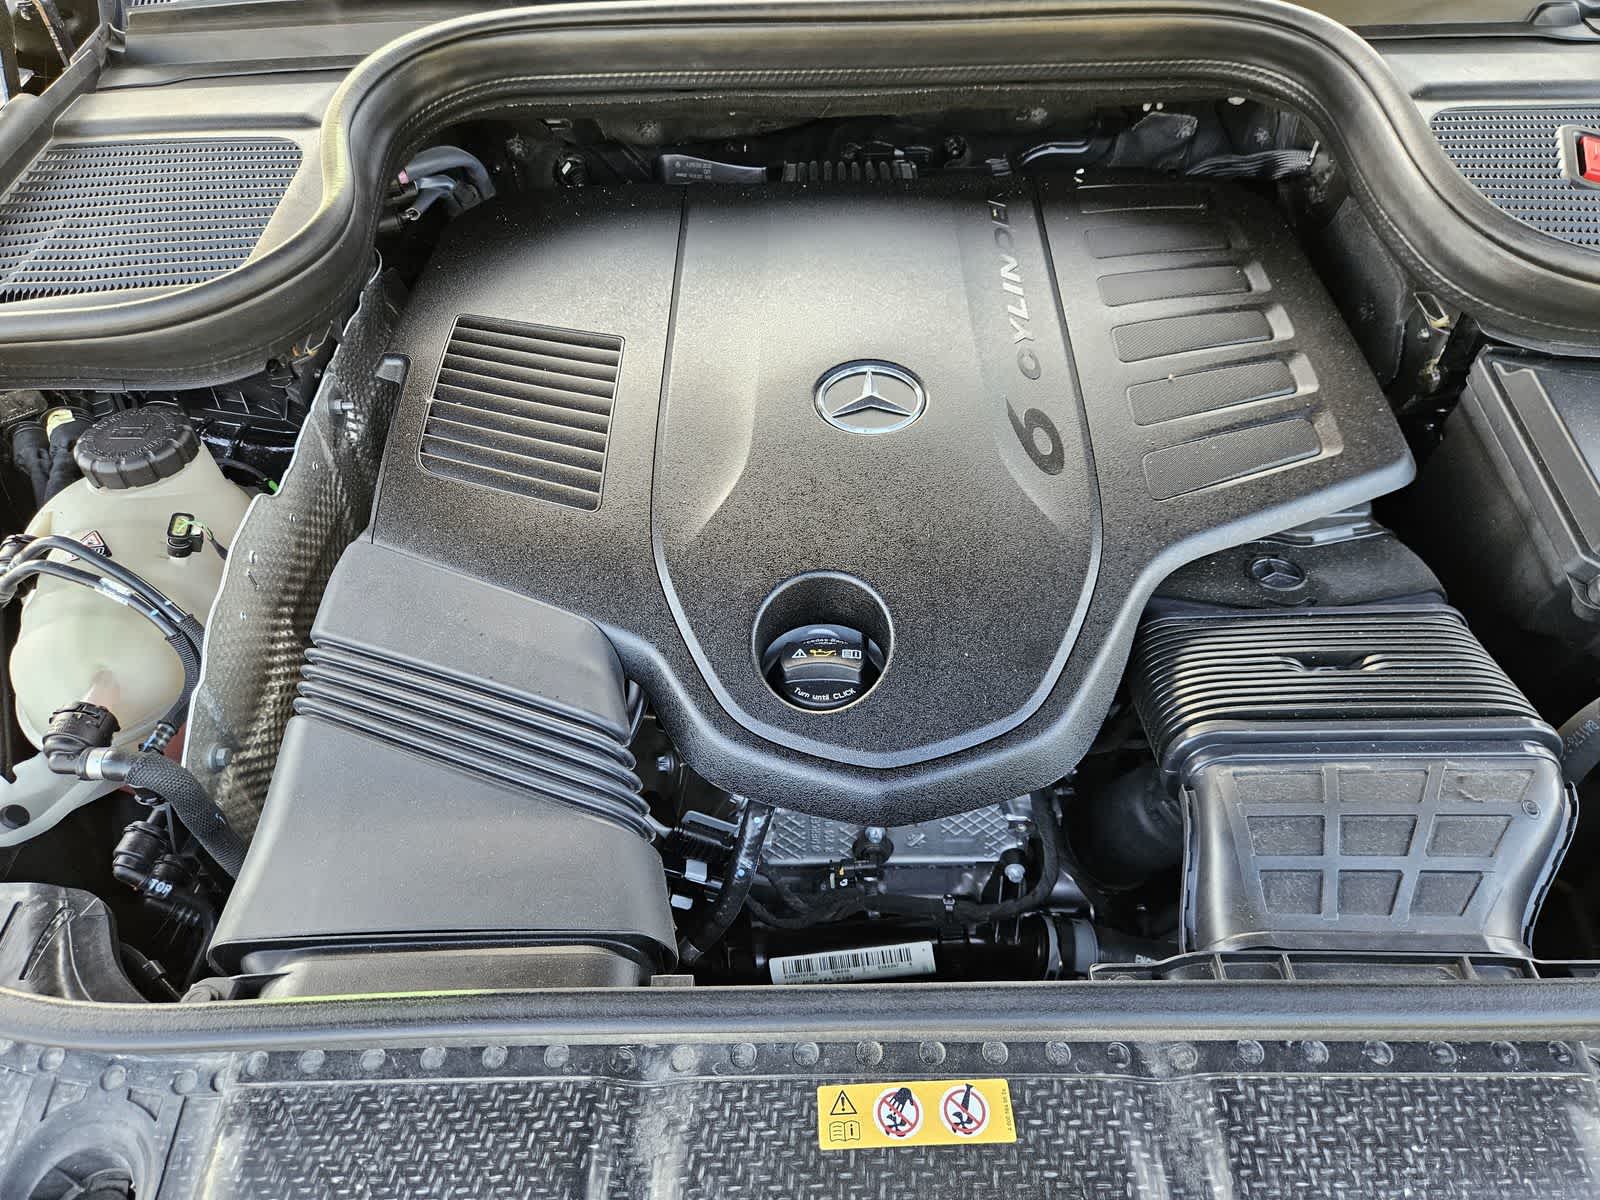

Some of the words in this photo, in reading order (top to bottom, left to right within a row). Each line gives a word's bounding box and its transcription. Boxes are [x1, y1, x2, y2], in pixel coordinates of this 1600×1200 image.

[1006, 398, 1065, 476] 6
[793, 687, 810, 698] Turn
[812, 693, 830, 701] until
[832, 687, 857, 700] CLICK
